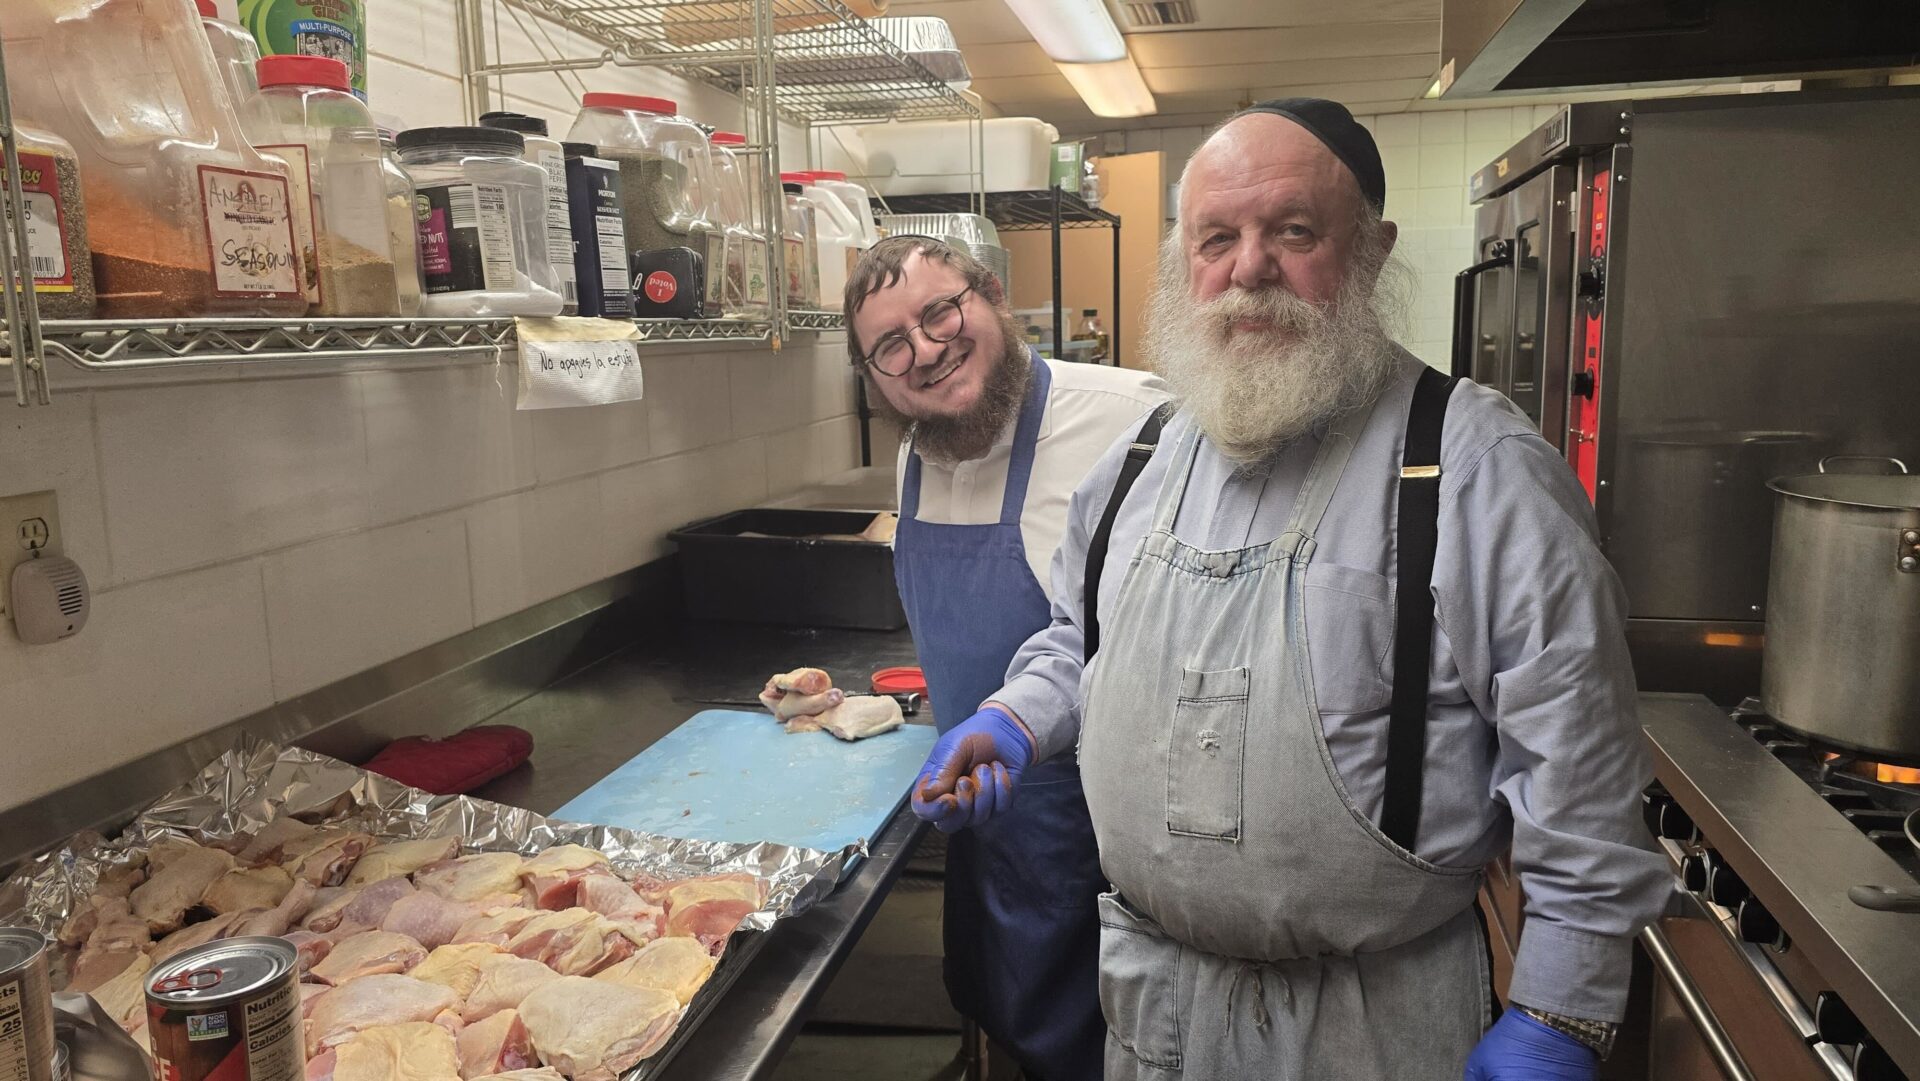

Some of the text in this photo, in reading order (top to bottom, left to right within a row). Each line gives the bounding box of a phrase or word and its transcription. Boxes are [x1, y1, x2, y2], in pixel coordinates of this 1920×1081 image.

[299, 22, 352, 41] MULTI-PURPOSE
[598, 189, 616, 199] MORTON
[649, 277, 674, 292] Voted
[540, 351, 553, 372] No
[593, 351, 606, 371] la
[2, 1017, 22, 1034] 25
[250, 1024, 291, 1050] Calories
